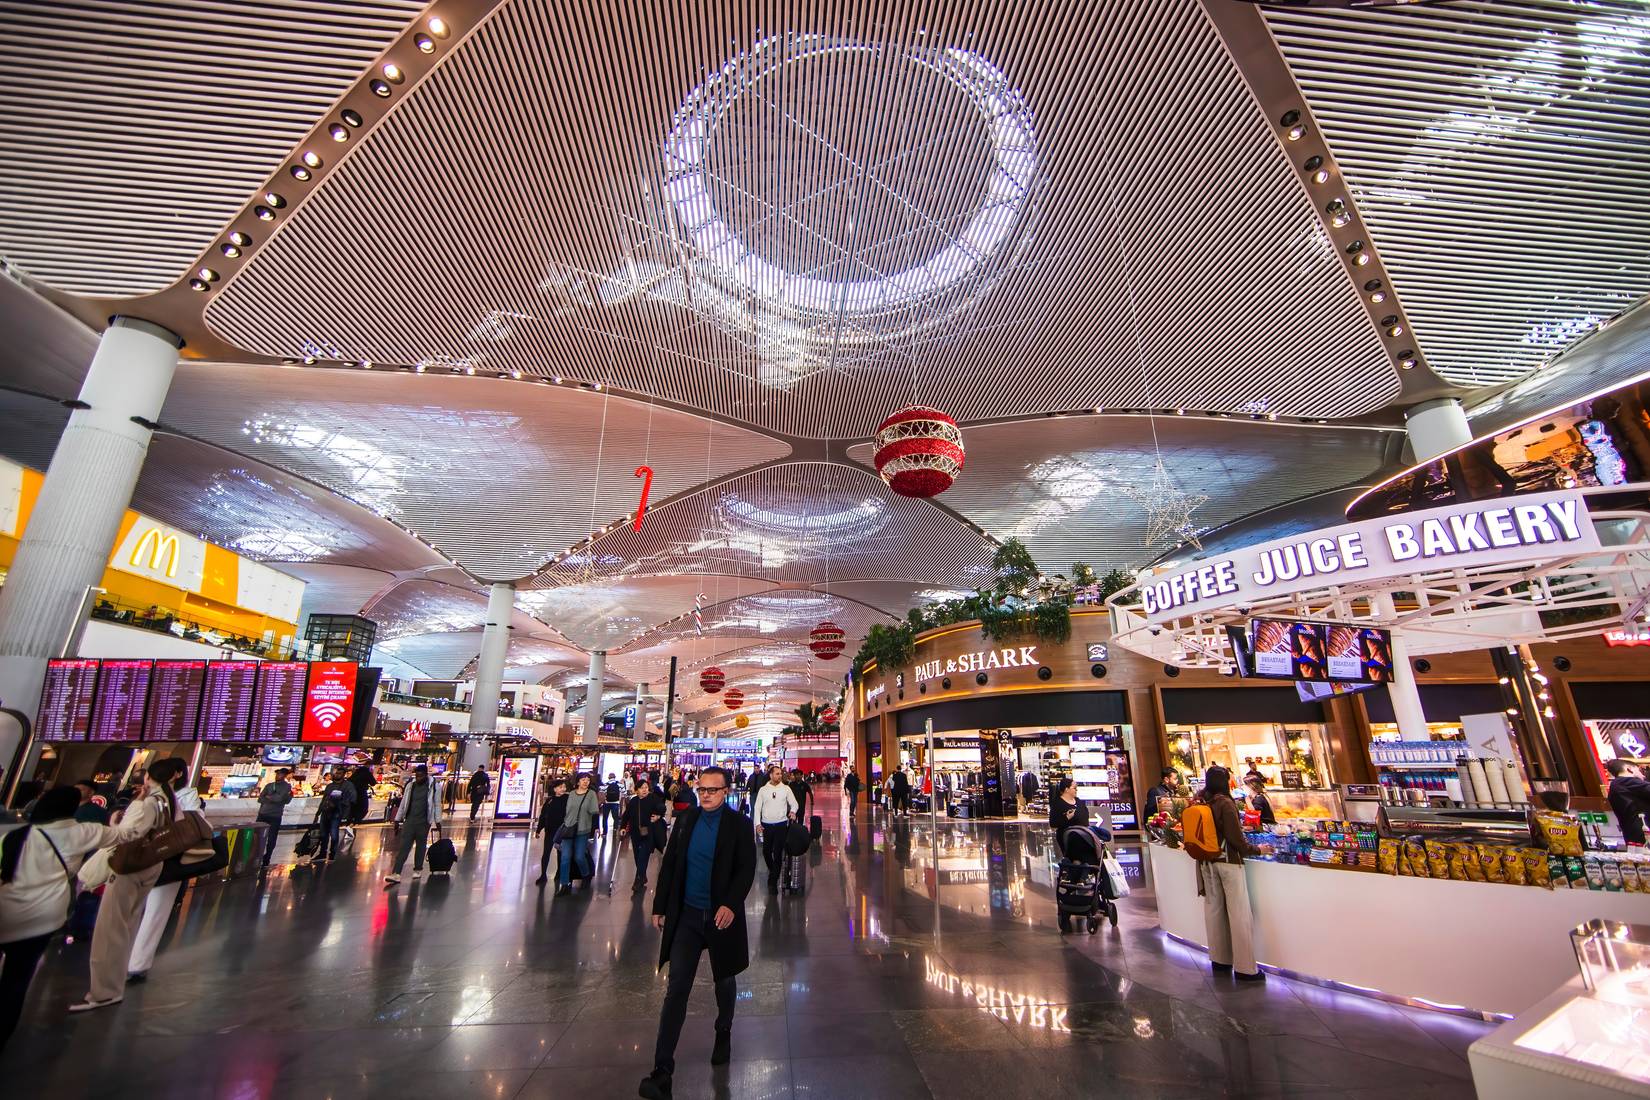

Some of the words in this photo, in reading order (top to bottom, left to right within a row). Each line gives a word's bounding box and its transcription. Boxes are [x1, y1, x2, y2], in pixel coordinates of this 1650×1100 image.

[1142, 560, 1239, 614] COFFEE
[1253, 532, 1369, 585] JUICE
[1384, 500, 1581, 562] BAKERY
[914, 660, 945, 682] PAUL
[958, 646, 1039, 672] SHARK
[627, 708, 635, 716] D
